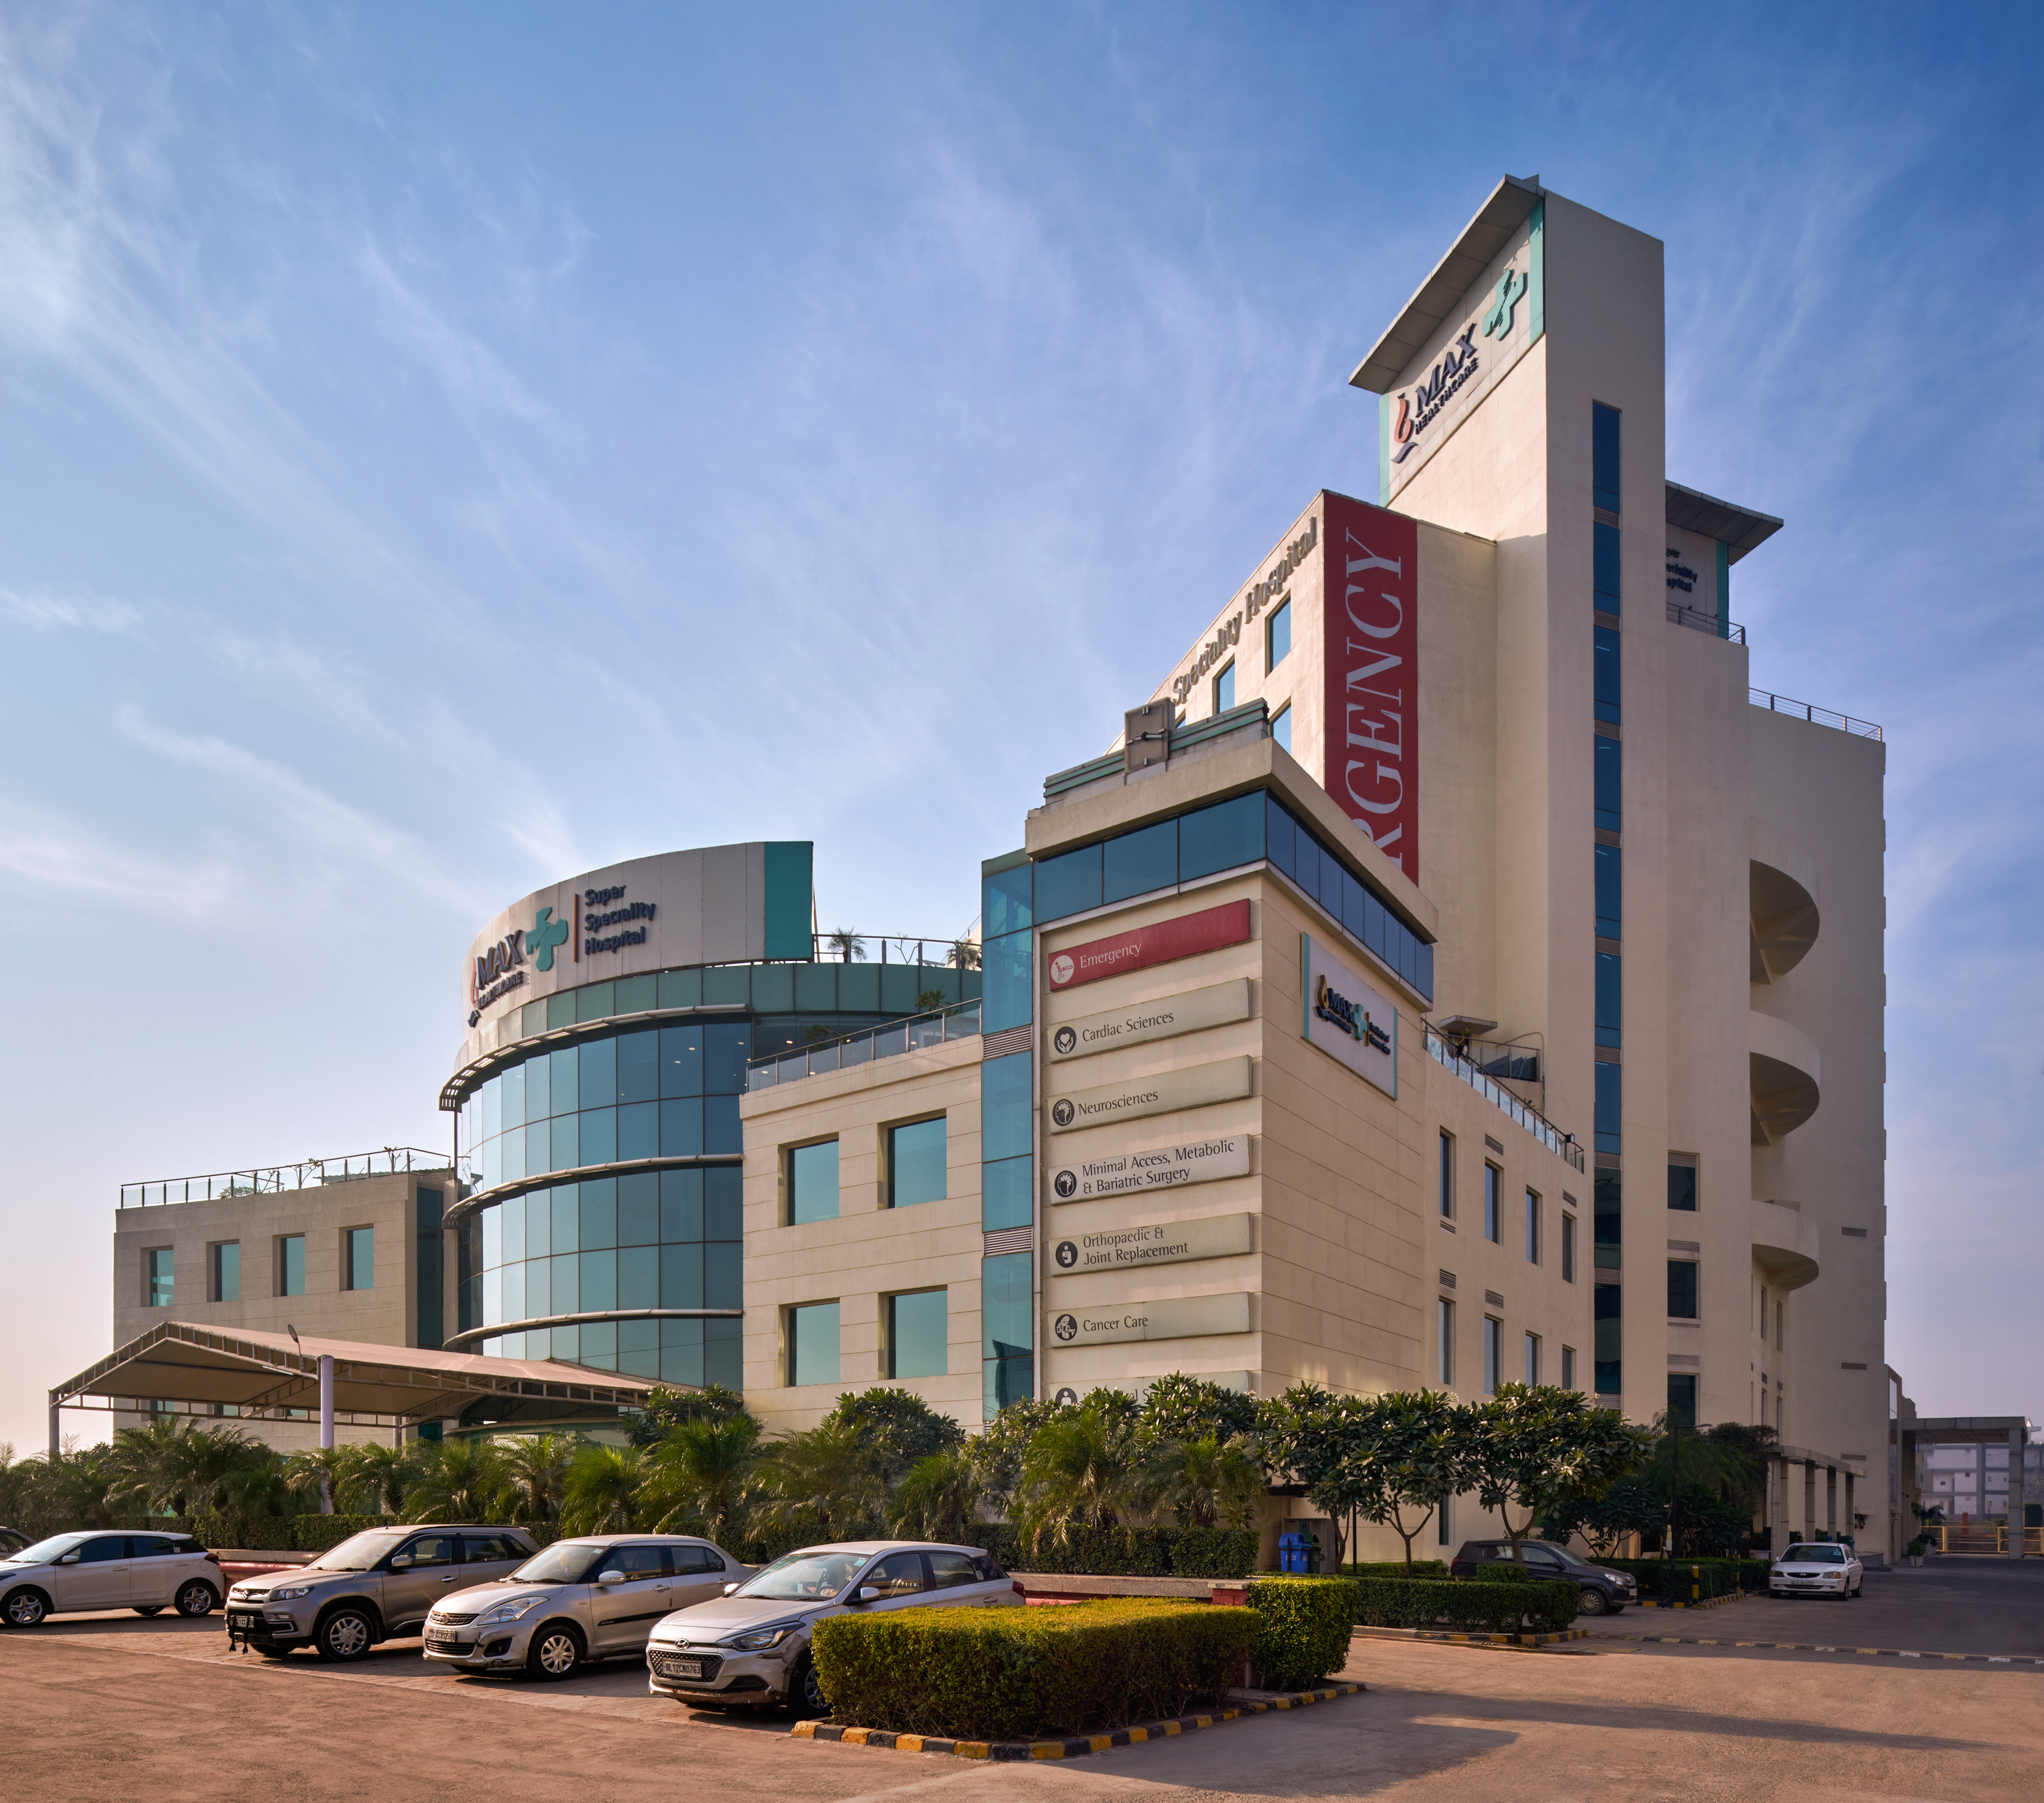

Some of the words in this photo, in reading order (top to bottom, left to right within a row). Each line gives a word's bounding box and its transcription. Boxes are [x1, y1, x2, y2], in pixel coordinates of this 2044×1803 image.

[1415, 323, 1478, 418] MAX
[1415, 357, 1479, 435] HEALTHCARE
[1666, 548, 1680, 559] per
[1245, 516, 1318, 624] Hospital
[1666, 578, 1692, 593] spital
[1346, 527, 1403, 871] RGENCY
[585, 885, 626, 907] Super
[585, 901, 655, 932] Speciality
[585, 926, 645, 955] Hospital
[477, 930, 524, 990] MAX
[1079, 943, 1141, 969] Emergency
[478, 971, 523, 1009] HEALTHCARE
[1328, 988, 1353, 1022] MAX
[1083, 1023, 1122, 1042] Cardiac
[1126, 1012, 1174, 1033] Sciences
[1329, 1011, 1352, 1034] HEALTHCARE
[1078, 1091, 1158, 1116] Neurosciences
[1082, 1158, 1127, 1177] Minimal
[1131, 1154, 1171, 1169] Access,
[1175, 1140, 1235, 1162] Metabolic
[1083, 1182, 1092, 1193] &
[1097, 1174, 1143, 1192] Bariatric
[1147, 1167, 1190, 1185] Surgery
[1083, 1229, 1150, 1248] Orthopaedic
[1155, 1227, 1164, 1239] &
[1083, 1250, 1112, 1265] Joint
[1116, 1242, 1189, 1263] Replacement
[1083, 1318, 1120, 1332] Cancer
[1124, 1315, 1149, 1328] Care
